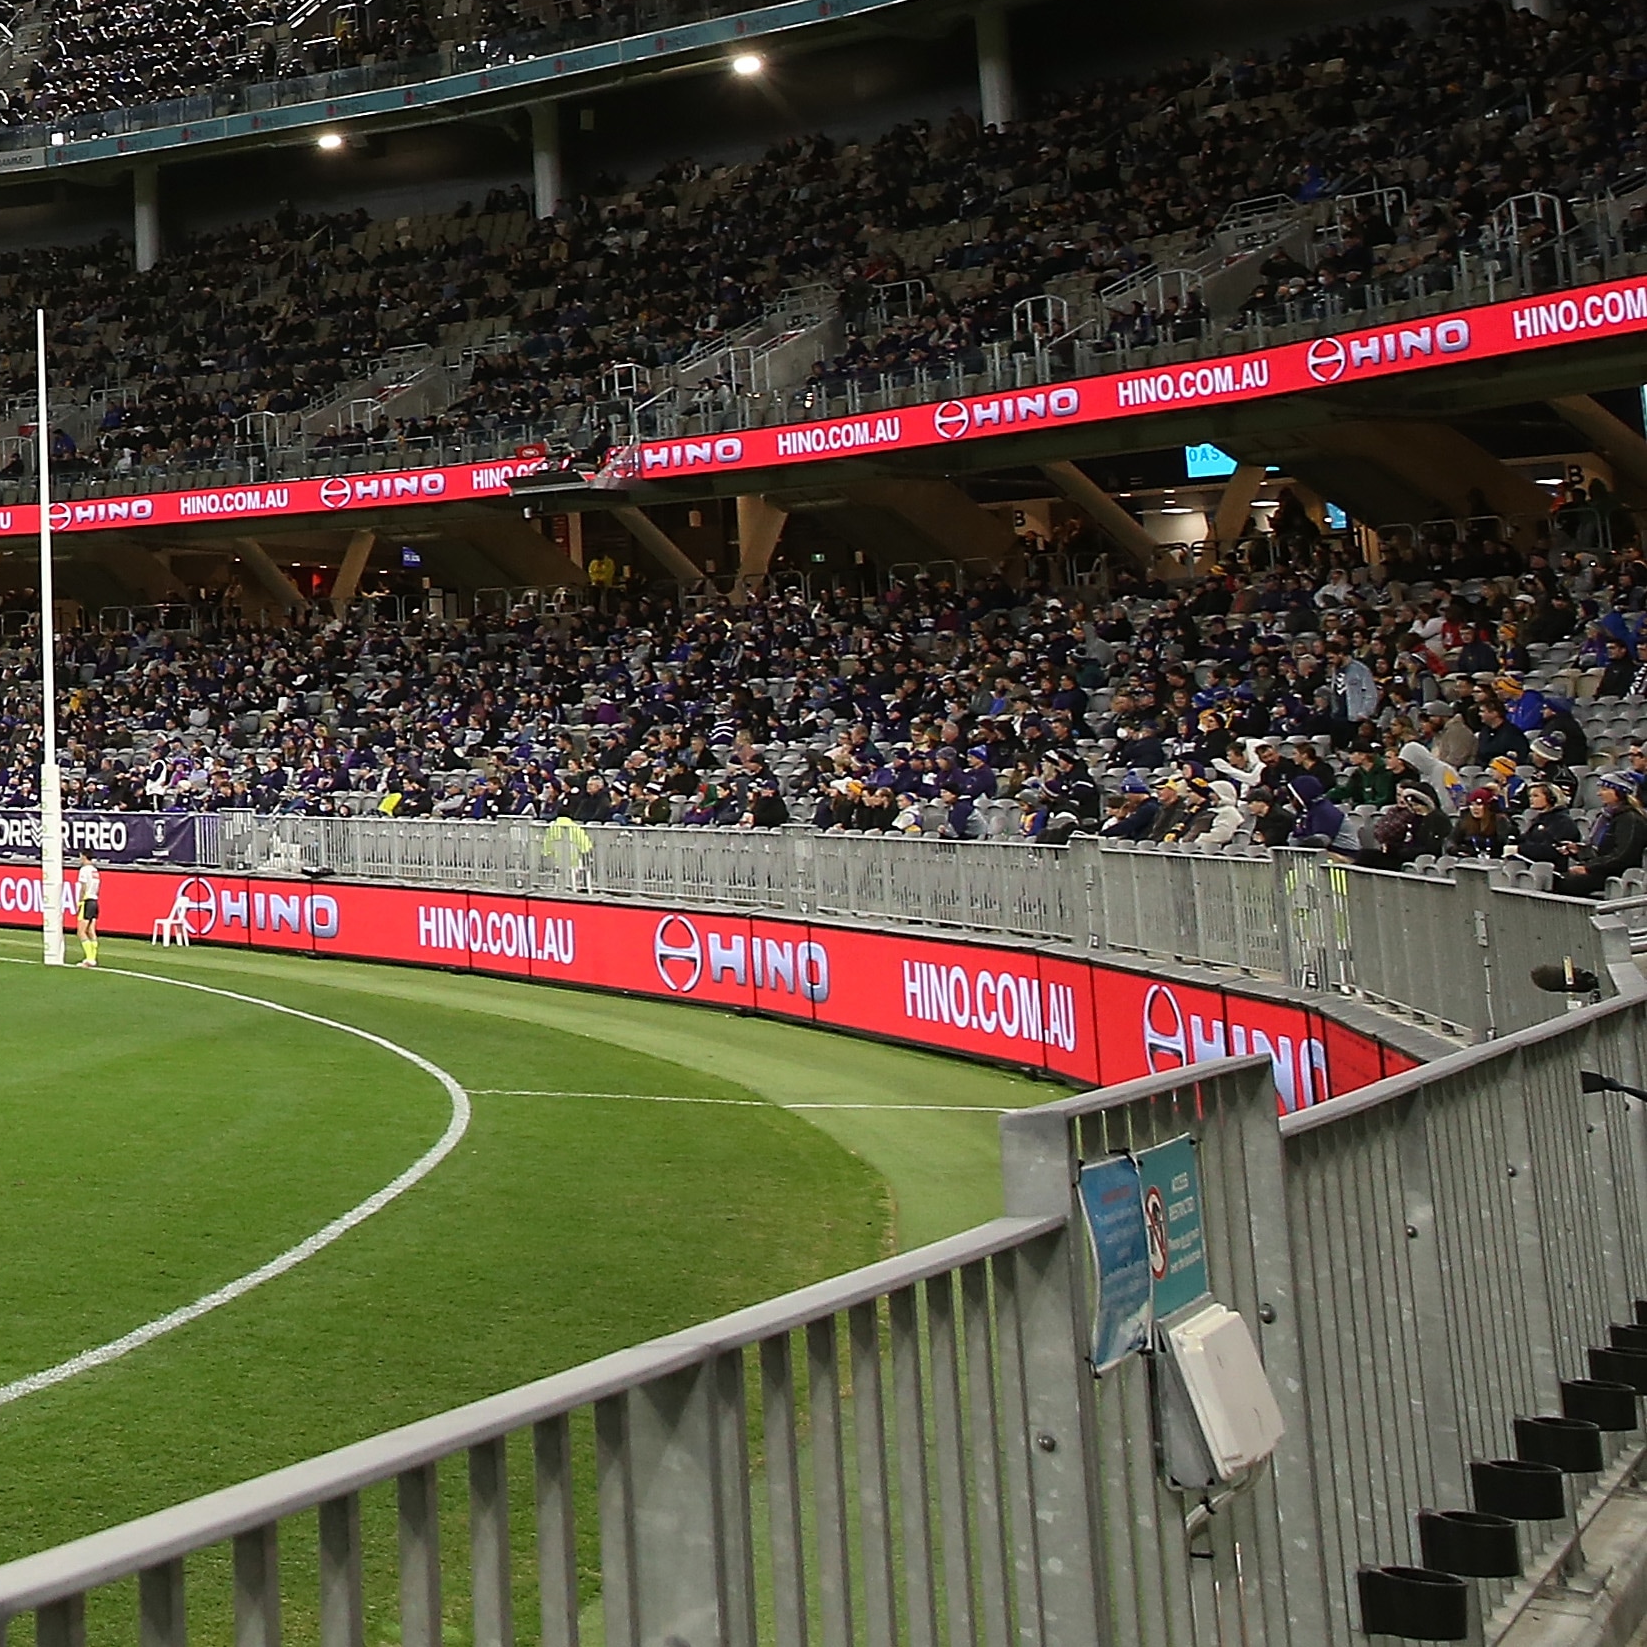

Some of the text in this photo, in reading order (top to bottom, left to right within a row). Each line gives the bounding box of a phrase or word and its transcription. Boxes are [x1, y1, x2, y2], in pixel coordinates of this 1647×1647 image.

[1349, 319, 1469, 366] HINO
[1117, 359, 1269, 407] HINO.COM.AU
[972, 387, 1079, 426] HINO
[643, 437, 742, 469] HINO
[777, 416, 900, 456] HINO.COM.AU
[1188, 448, 1221, 463] OAS
[354, 471, 445, 499] HINO
[1569, 465, 1584, 484] B
[74, 499, 153, 523] HINO
[180, 488, 289, 515] HINO.COM.AU
[73, 819, 127, 851] FREO
[220, 889, 338, 937] HINO
[418, 905, 574, 965] HINO.COM.AU
[707, 932, 829, 1000] HINO
[903, 960, 1076, 1052] HINO.COM.AU
